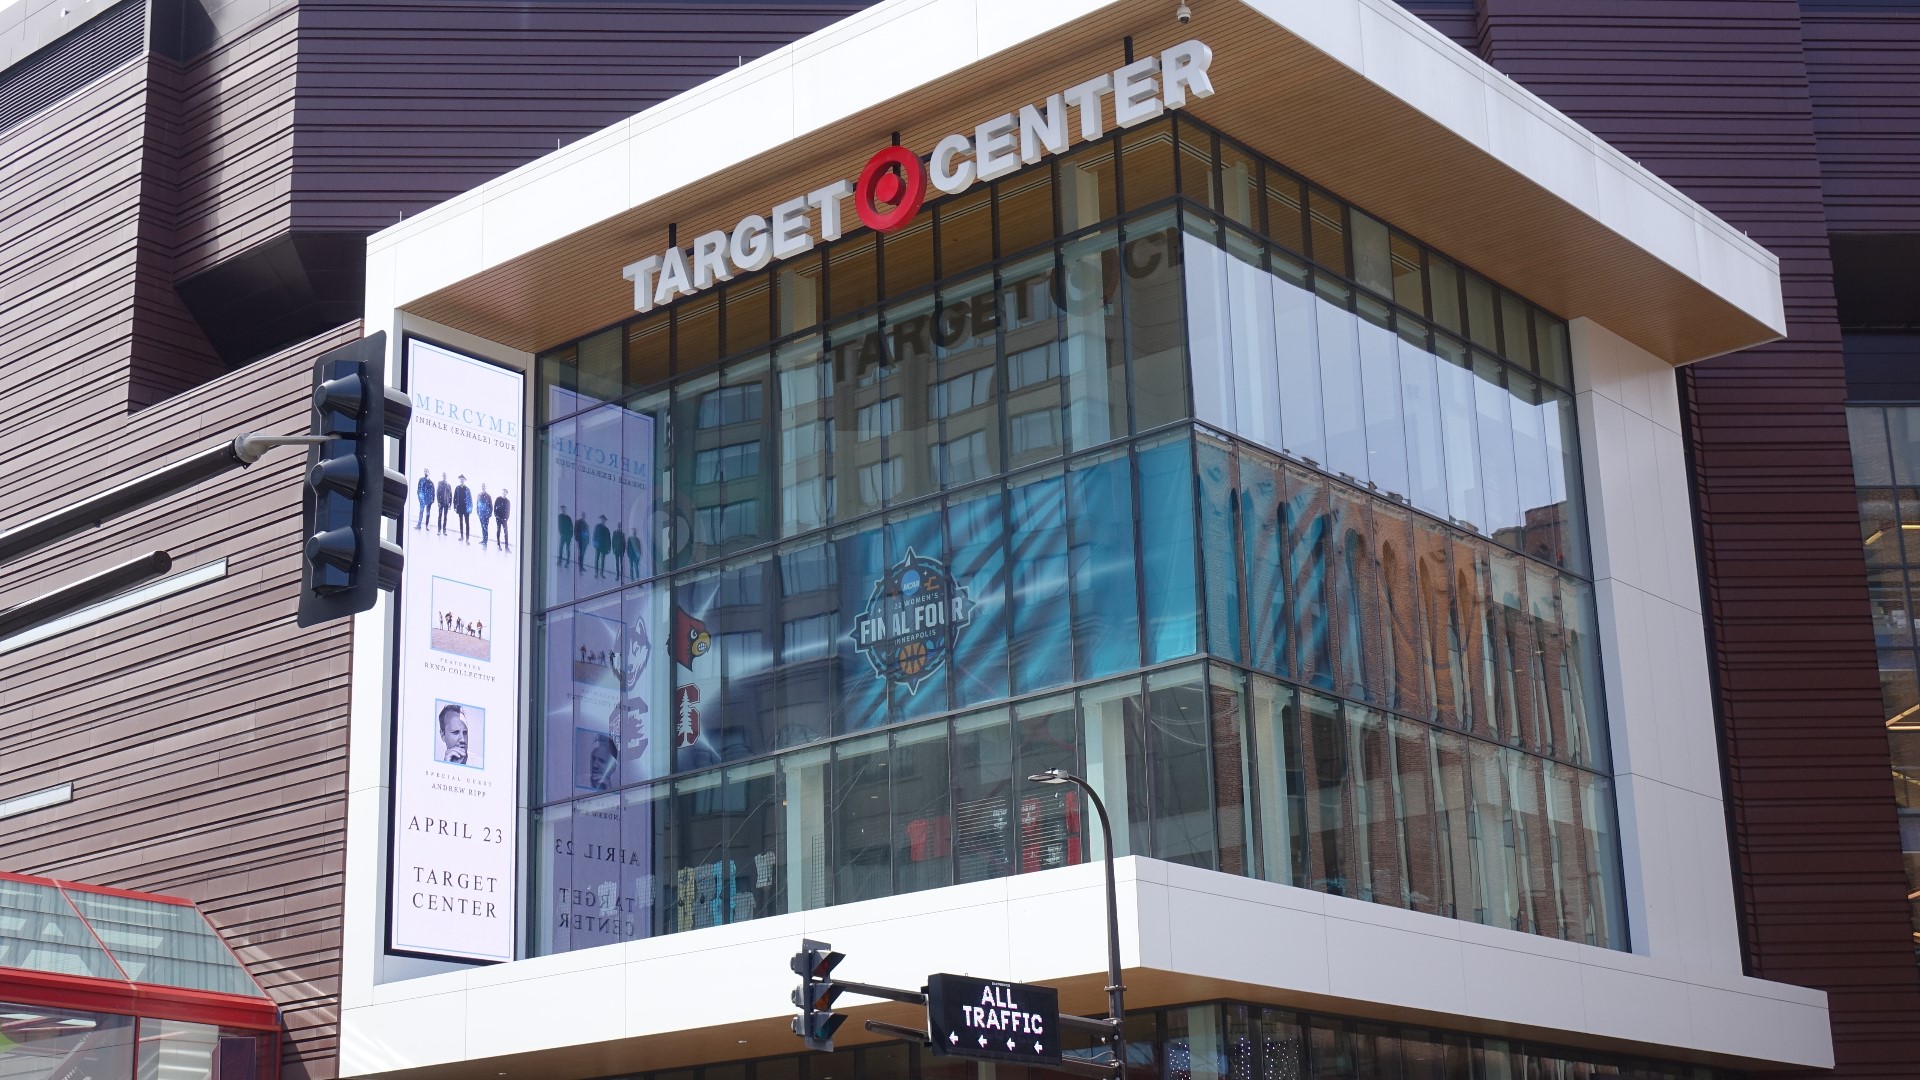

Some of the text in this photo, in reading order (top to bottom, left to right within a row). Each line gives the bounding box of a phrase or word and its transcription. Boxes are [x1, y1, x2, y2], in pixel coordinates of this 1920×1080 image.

[622, 39, 1215, 313] TARGET CENTER
[415, 392, 517, 438] MERCYME
[415, 415, 516, 451] INHALE (EXHALE) TOUR
[904, 592, 939, 607] WOMEN'S
[860, 611, 909, 645] FINAL
[893, 629, 936, 646] INNEAPOLIS
[424, 661, 496, 683] REND COLLECTIVE
[425, 770, 461, 782] SPECIAL
[431, 783, 466, 794] ANDREW
[408, 815, 502, 844] APRIL 23
[413, 866, 498, 893] TARGET
[412, 892, 497, 918] CENTER
[981, 984, 1018, 1010] ALL
[962, 1005, 1043, 1035] TRAFFIC
